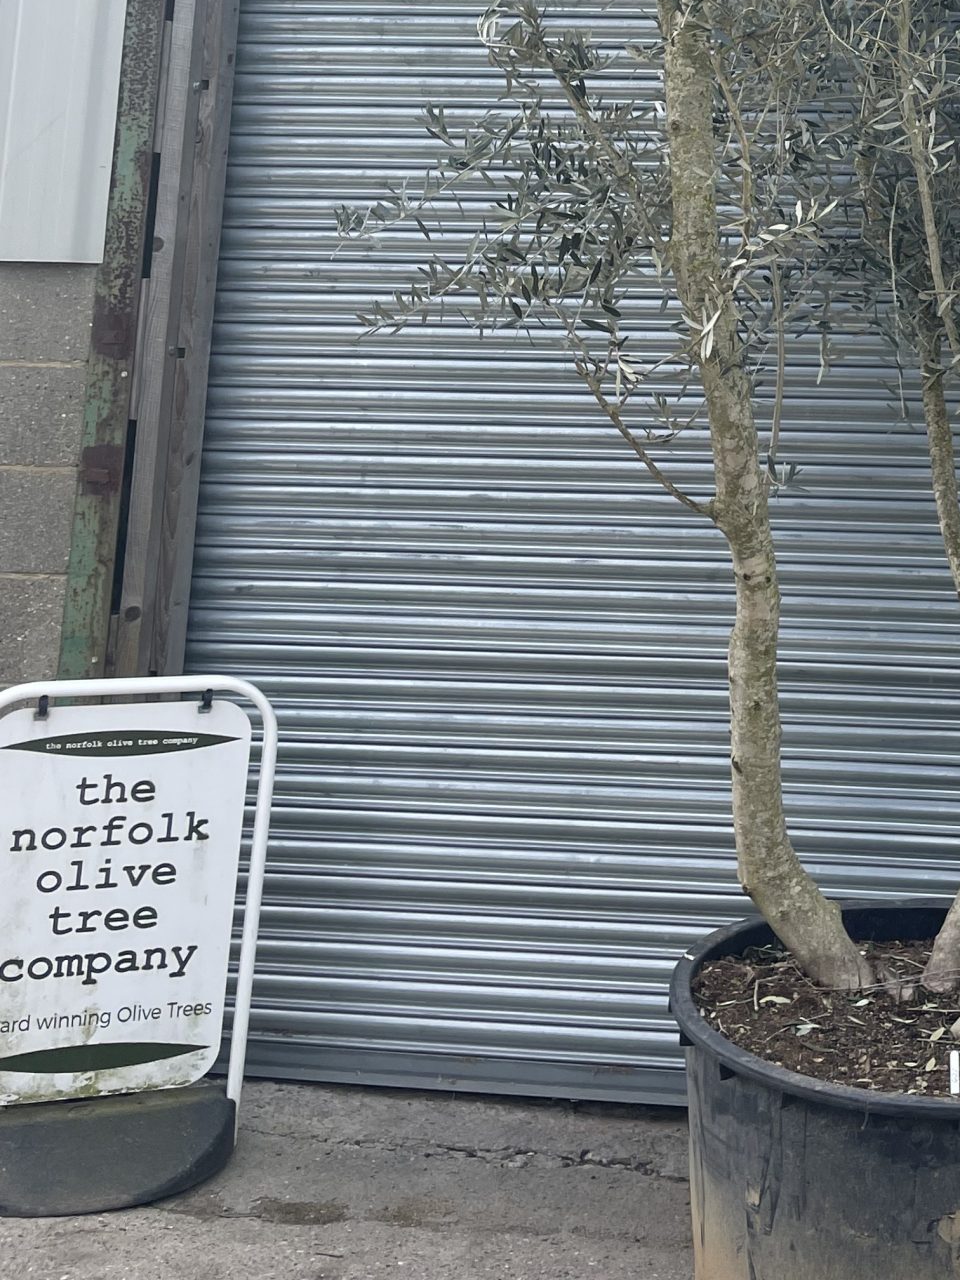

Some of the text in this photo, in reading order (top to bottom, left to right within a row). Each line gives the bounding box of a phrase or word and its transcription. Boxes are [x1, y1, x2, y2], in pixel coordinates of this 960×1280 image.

[45, 742, 62, 750] the
[65, 740, 103, 749] norfolk
[106, 739, 134, 747] olive
[162, 737, 199, 746] company
[76, 774, 156, 806] the
[9, 811, 210, 852] norfolk
[36, 858, 177, 893] olive
[48, 906, 158, 935] tree
[0, 945, 198, 986] company
[0, 998, 212, 1033] ard winning Olive Trees
